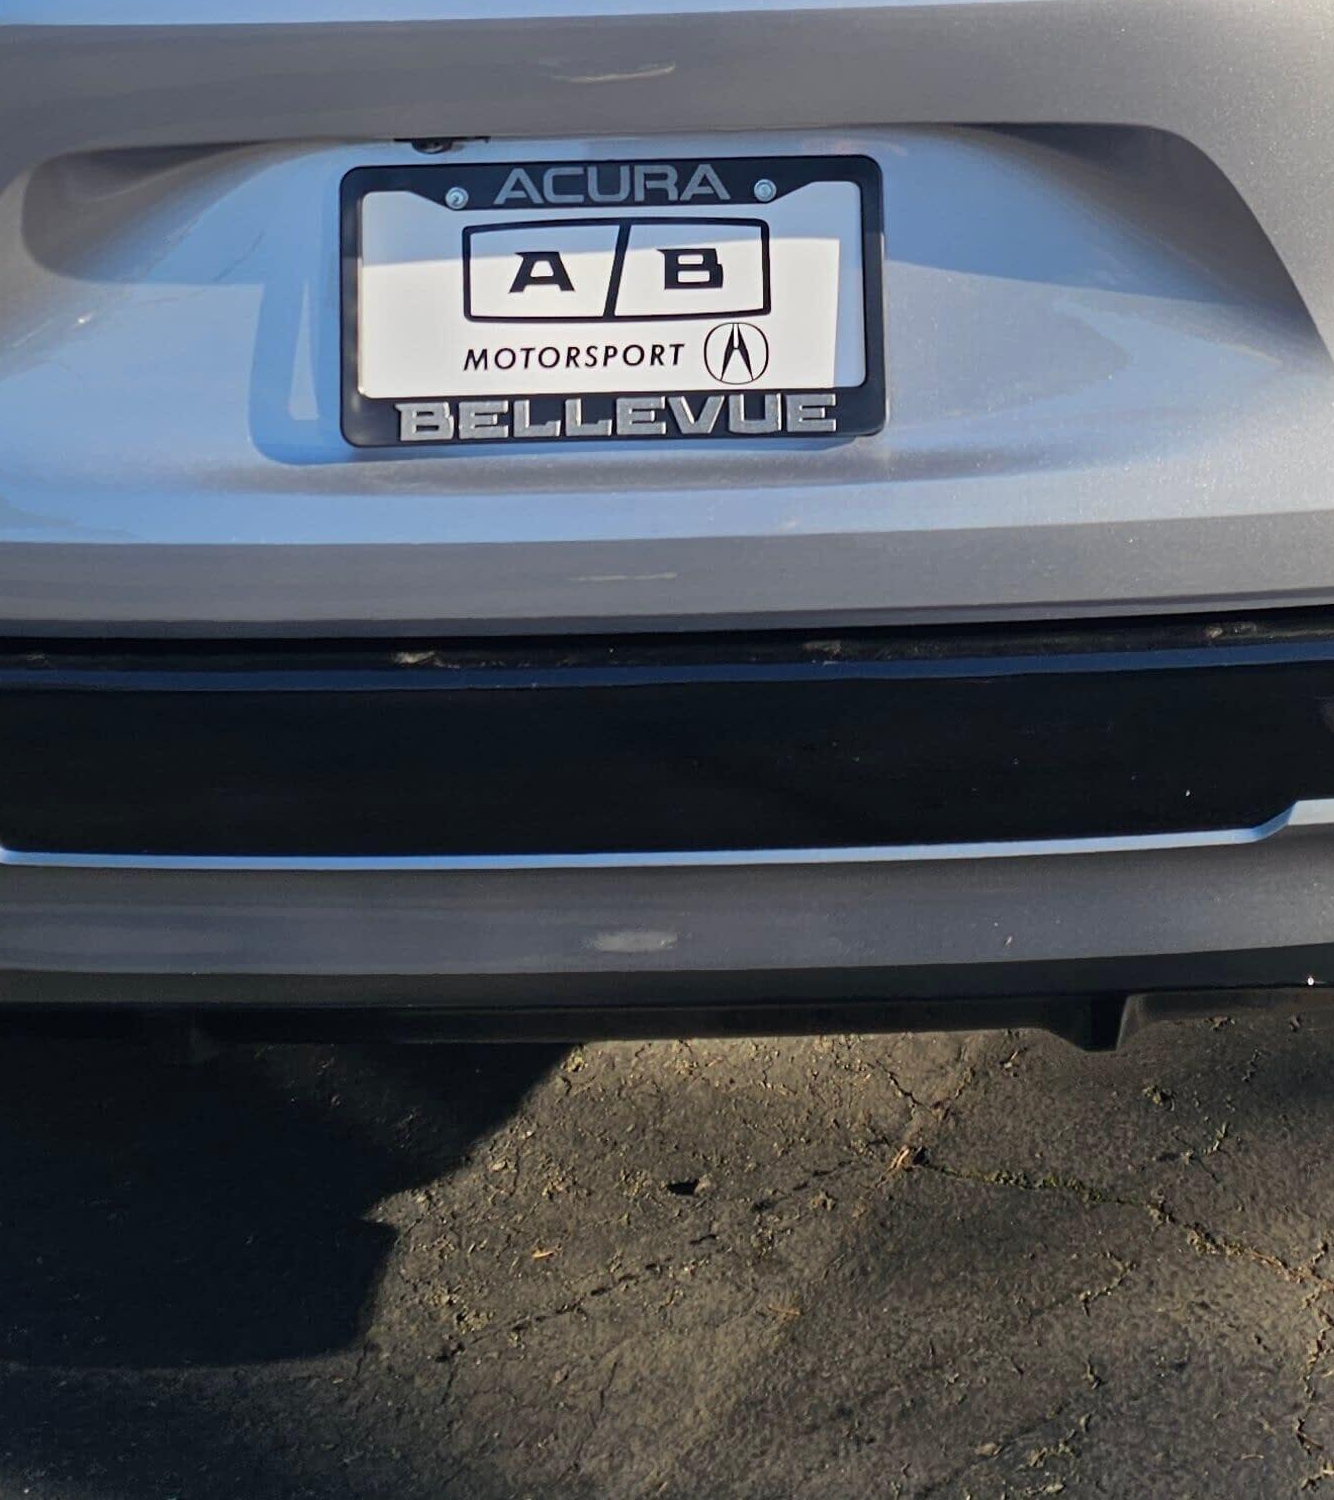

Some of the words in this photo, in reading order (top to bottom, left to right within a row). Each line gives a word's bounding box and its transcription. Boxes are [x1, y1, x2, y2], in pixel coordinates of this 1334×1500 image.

[494, 163, 730, 206] ACURA
[463, 342, 686, 373] MOTORSPORT
[393, 393, 838, 442] BELLEVUE
